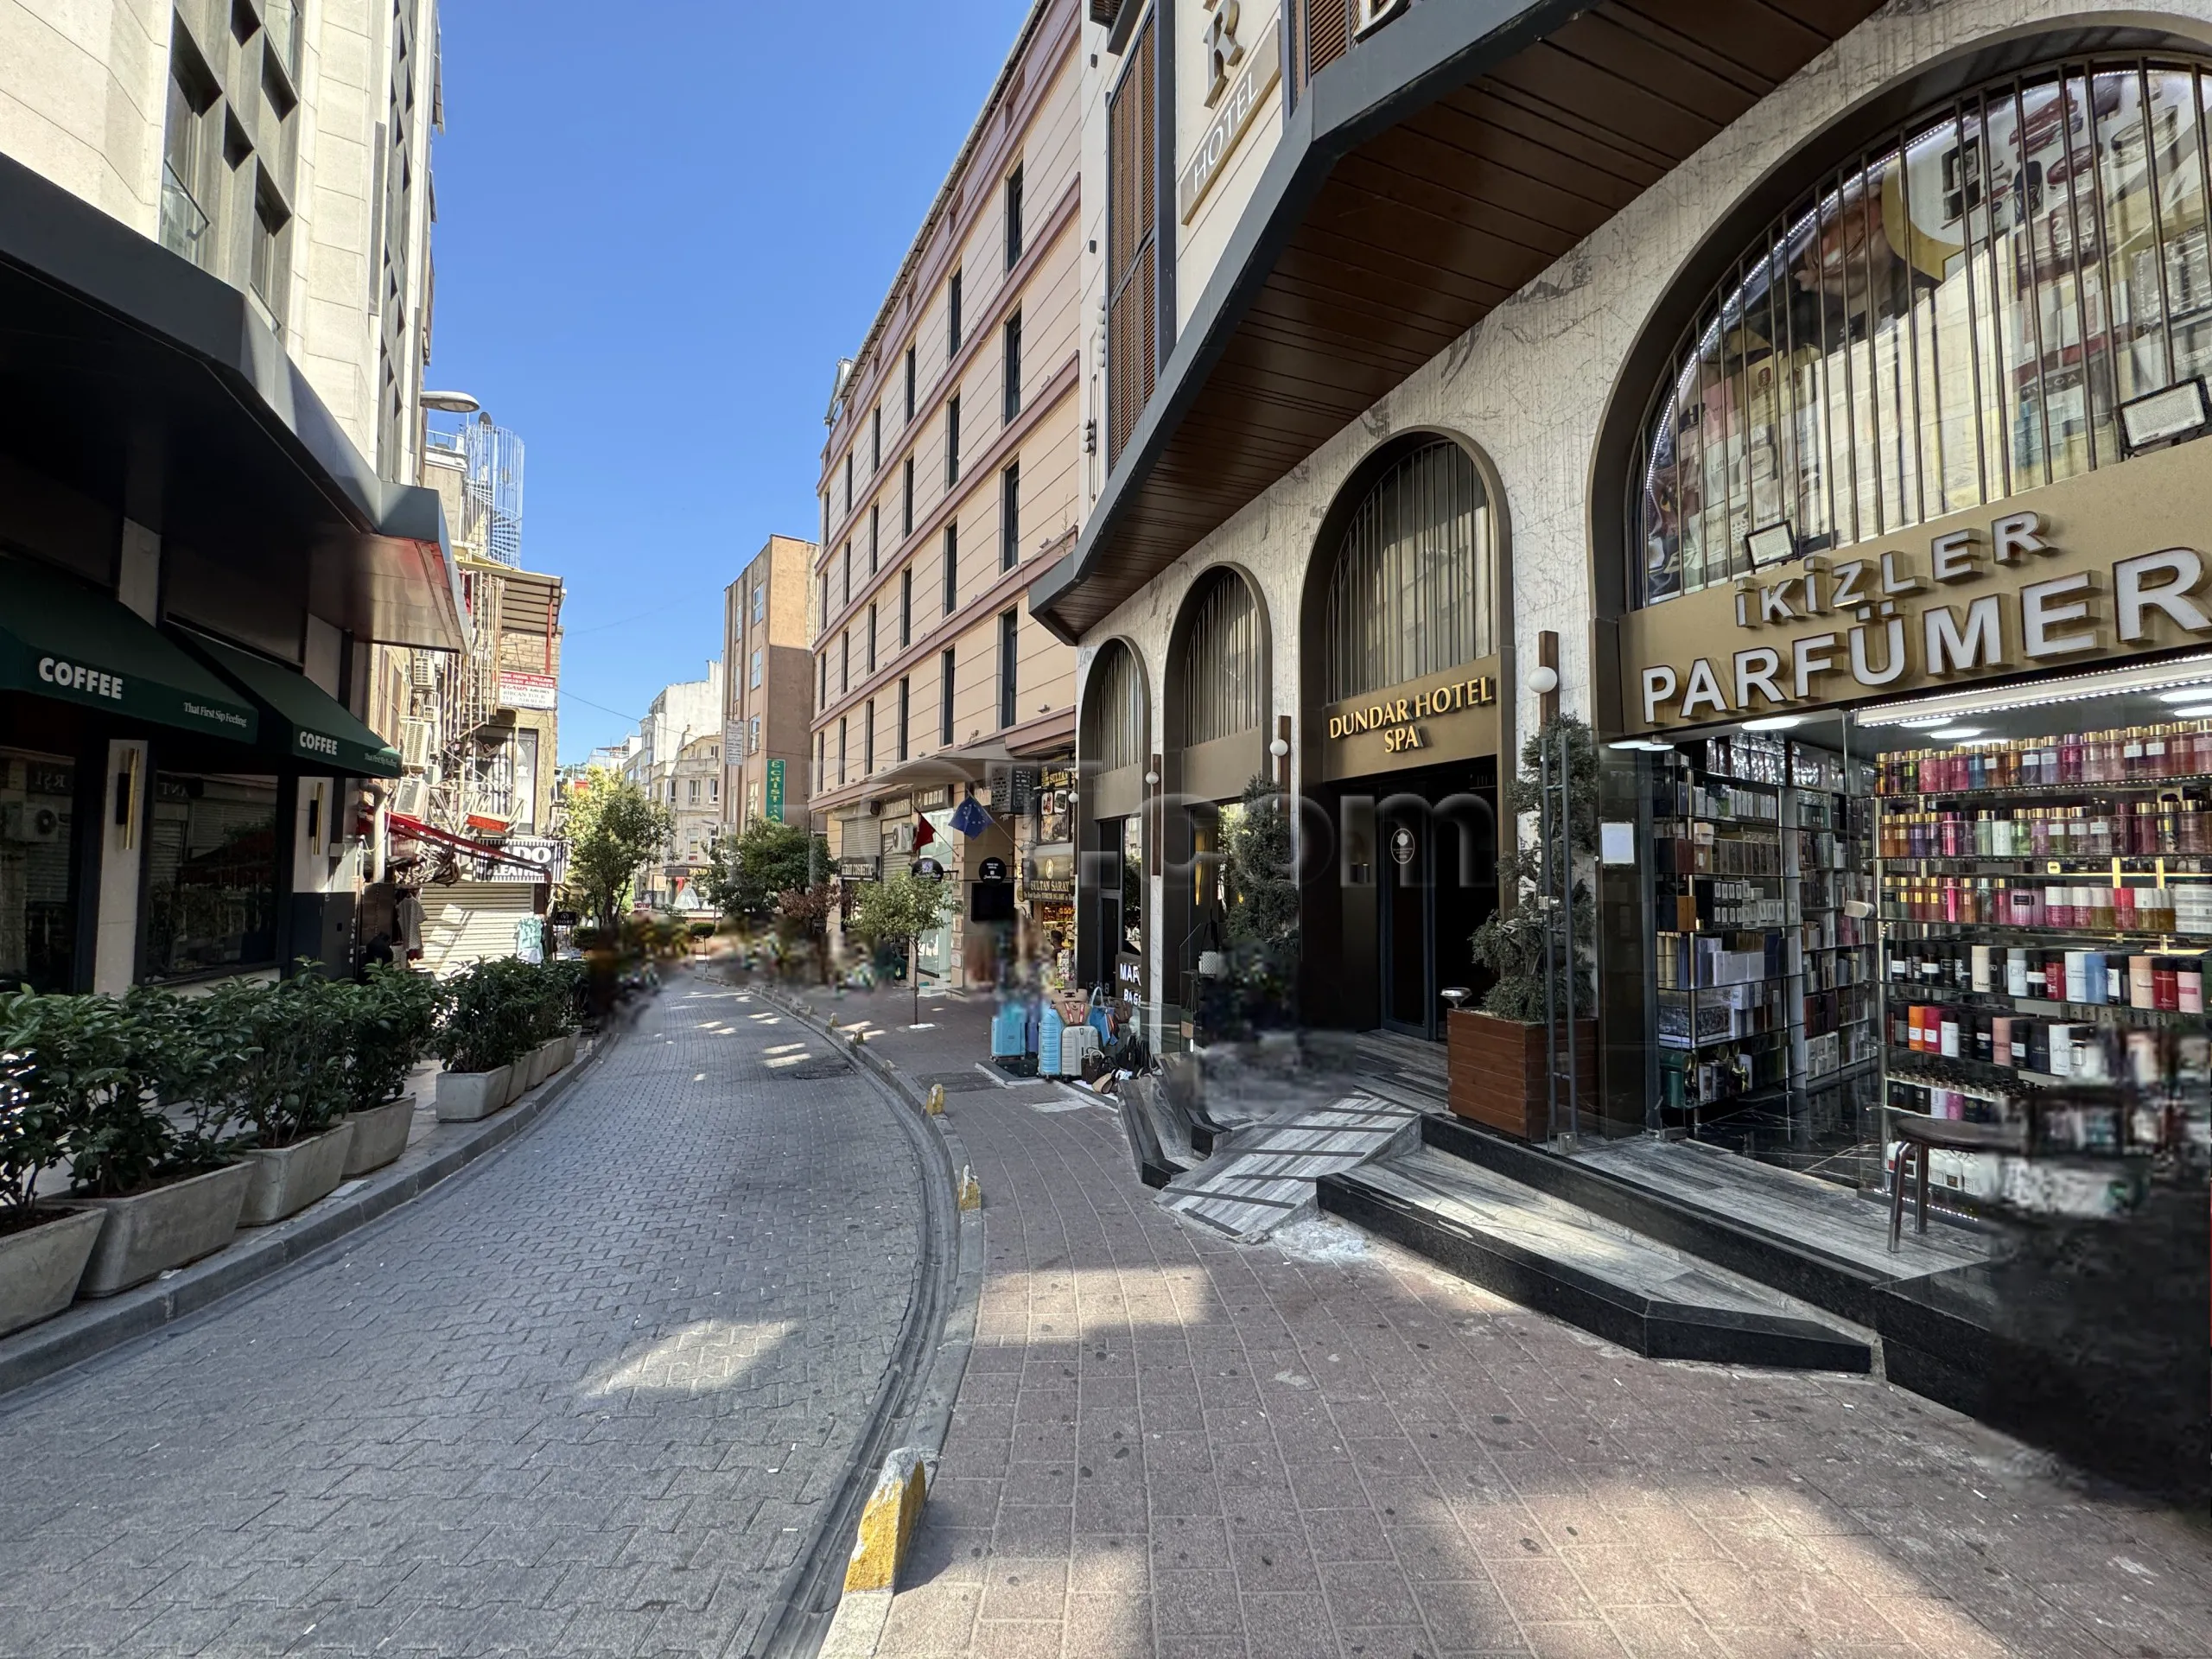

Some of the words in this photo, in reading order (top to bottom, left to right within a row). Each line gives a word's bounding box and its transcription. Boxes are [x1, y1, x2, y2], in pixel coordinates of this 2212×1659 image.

[1194, 72, 1259, 194] HOTEL
[1735, 511, 2050, 628] İKİZLER
[1642, 547, 2212, 724] PARFÜMER
[39, 657, 124, 700] COFFEE
[183, 701, 200, 715] That
[200, 706, 214, 718] First
[215, 709, 226, 722] Sip
[226, 713, 247, 728] Feeling
[1329, 698, 1410, 739] DUNDAR
[1414, 676, 1493, 718] HOTEL
[299, 731, 338, 756] COFFEE
[1384, 725, 1420, 753] SPA
[1030, 880, 1050, 891] SULTAN
[1051, 880, 1070, 892] SARAY
